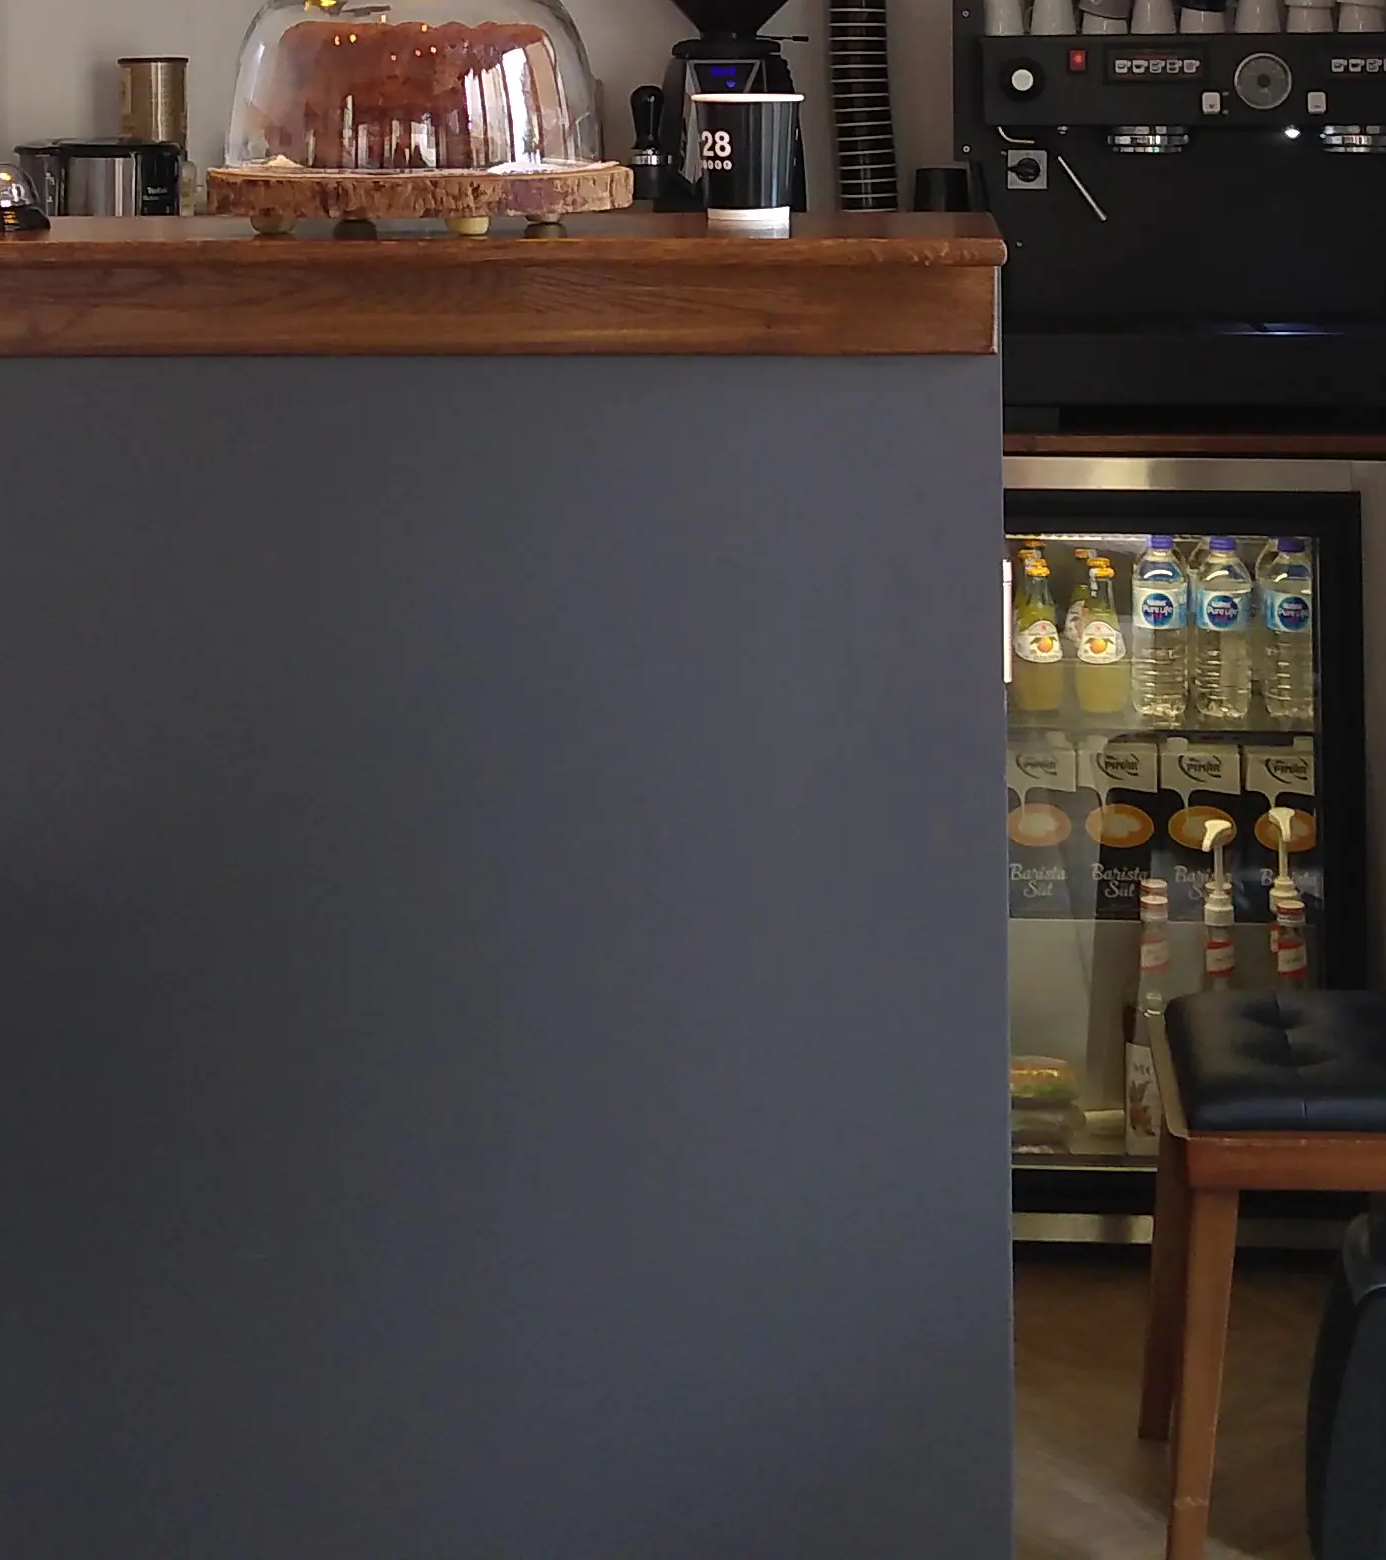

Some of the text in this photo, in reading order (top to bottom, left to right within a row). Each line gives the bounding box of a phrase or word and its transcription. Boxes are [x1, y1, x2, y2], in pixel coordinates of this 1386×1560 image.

[701, 130, 732, 158] 28
[1009, 863, 1066, 881] Barista
[1091, 862, 1150, 881] Barista
